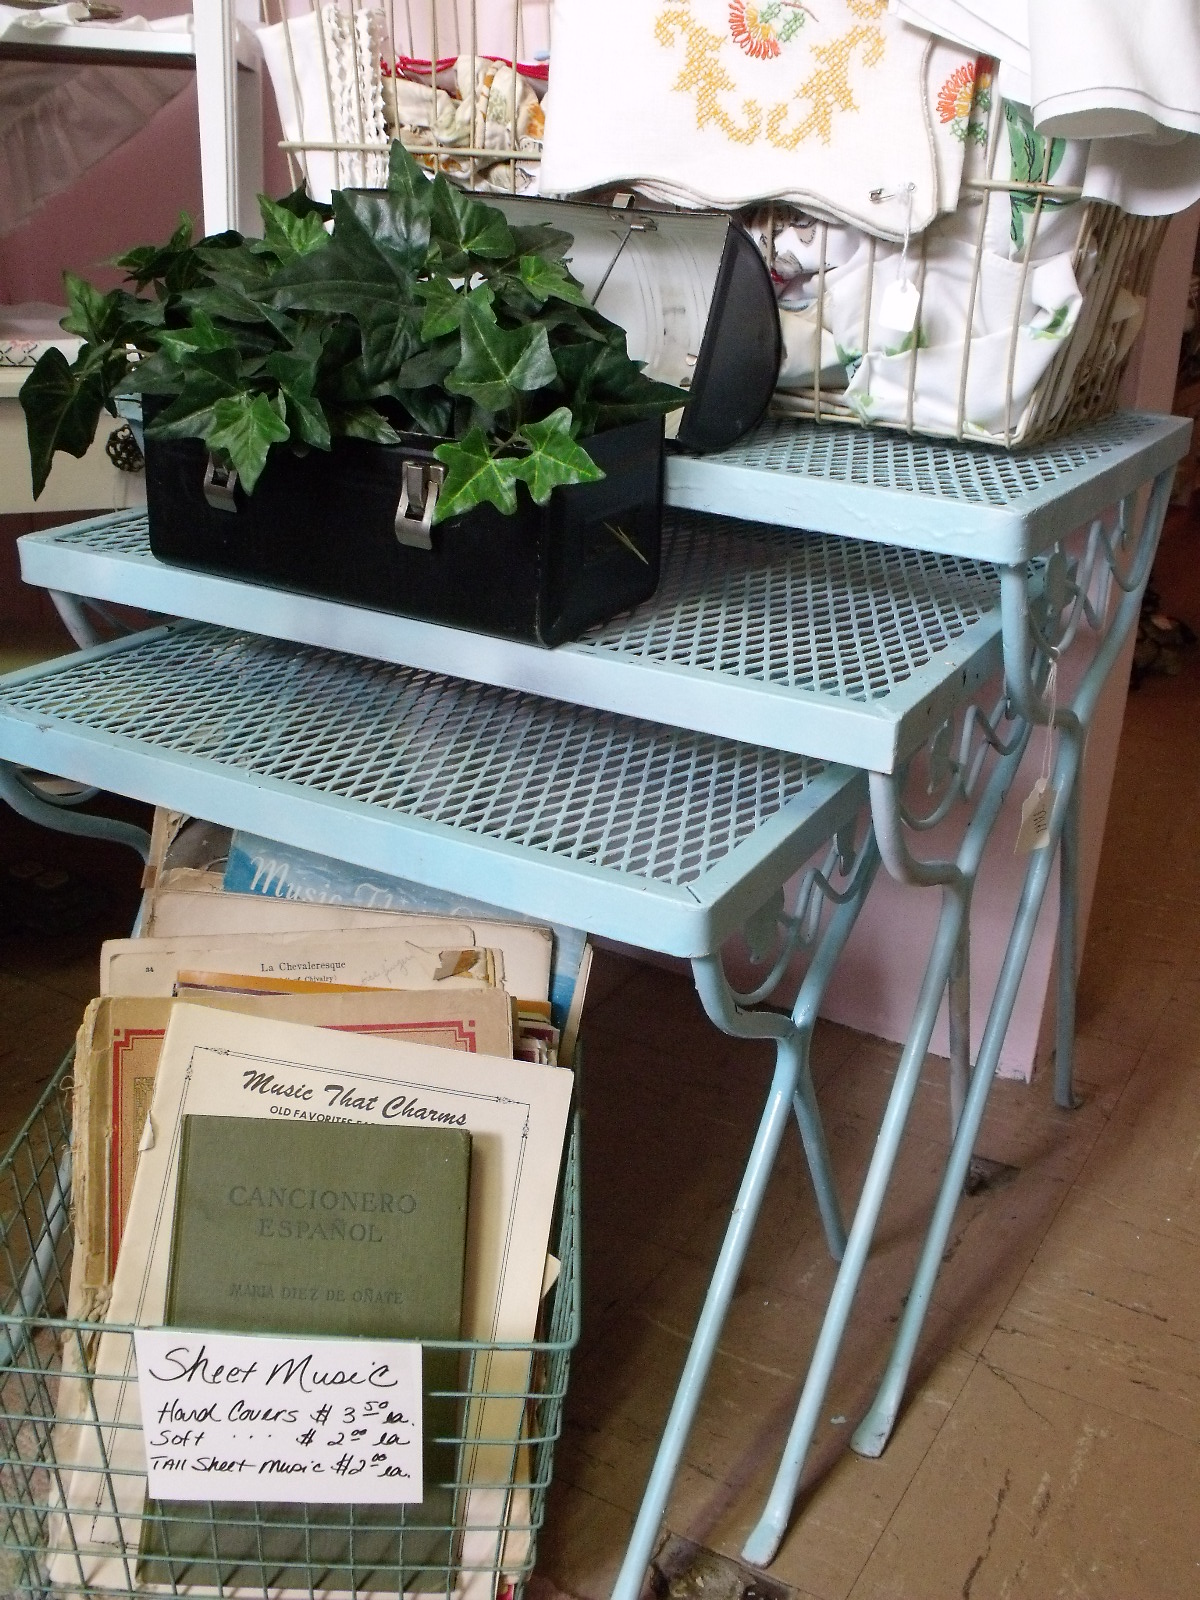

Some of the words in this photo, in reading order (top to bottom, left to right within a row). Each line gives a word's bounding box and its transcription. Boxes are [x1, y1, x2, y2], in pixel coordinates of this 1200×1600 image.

[260, 963, 274, 972] La
[279, 961, 346, 972] Chevaleresque
[243, 1069, 313, 1101] Music
[324, 1084, 377, 1112] That
[381, 1095, 468, 1126] Charms
[269, 1105, 291, 1116] OLD
[227, 1184, 418, 1216] CANCIONERO
[257, 1216, 384, 1244] ESPAÑOL
[326, 1289, 346, 1302] DE
[352, 1288, 405, 1305] OÑATE
[149, 1345, 257, 1384] Sheet
[265, 1354, 399, 1393] Music
[157, 1398, 222, 1425] Hard
[227, 1399, 299, 1423] Covers
[150, 1430, 205, 1447] Soft
[191, 1456, 257, 1474] Sheet
